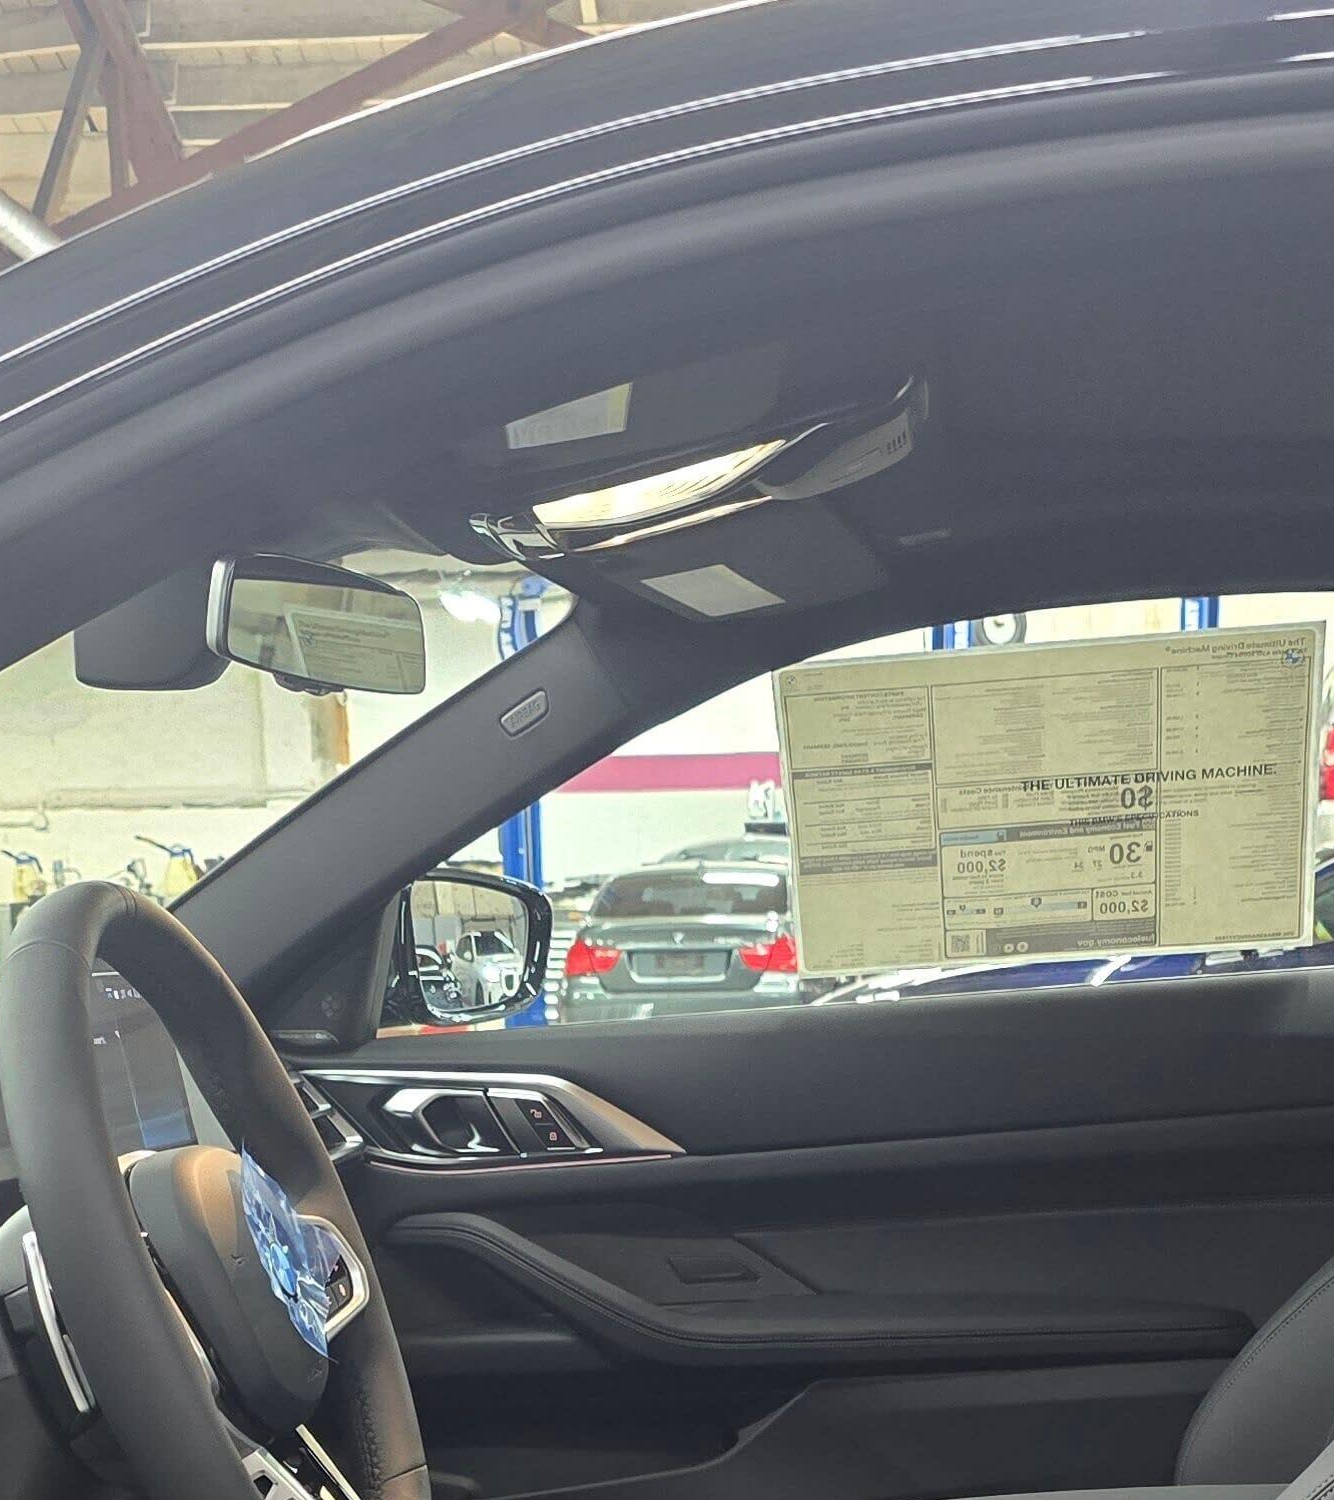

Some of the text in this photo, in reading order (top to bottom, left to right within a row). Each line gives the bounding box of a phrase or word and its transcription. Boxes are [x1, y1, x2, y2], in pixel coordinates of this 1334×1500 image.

[1020, 779, 1051, 792] THE
[1055, 774, 1130, 790] ULTIMATE
[1134, 769, 1197, 785] DRIVING
